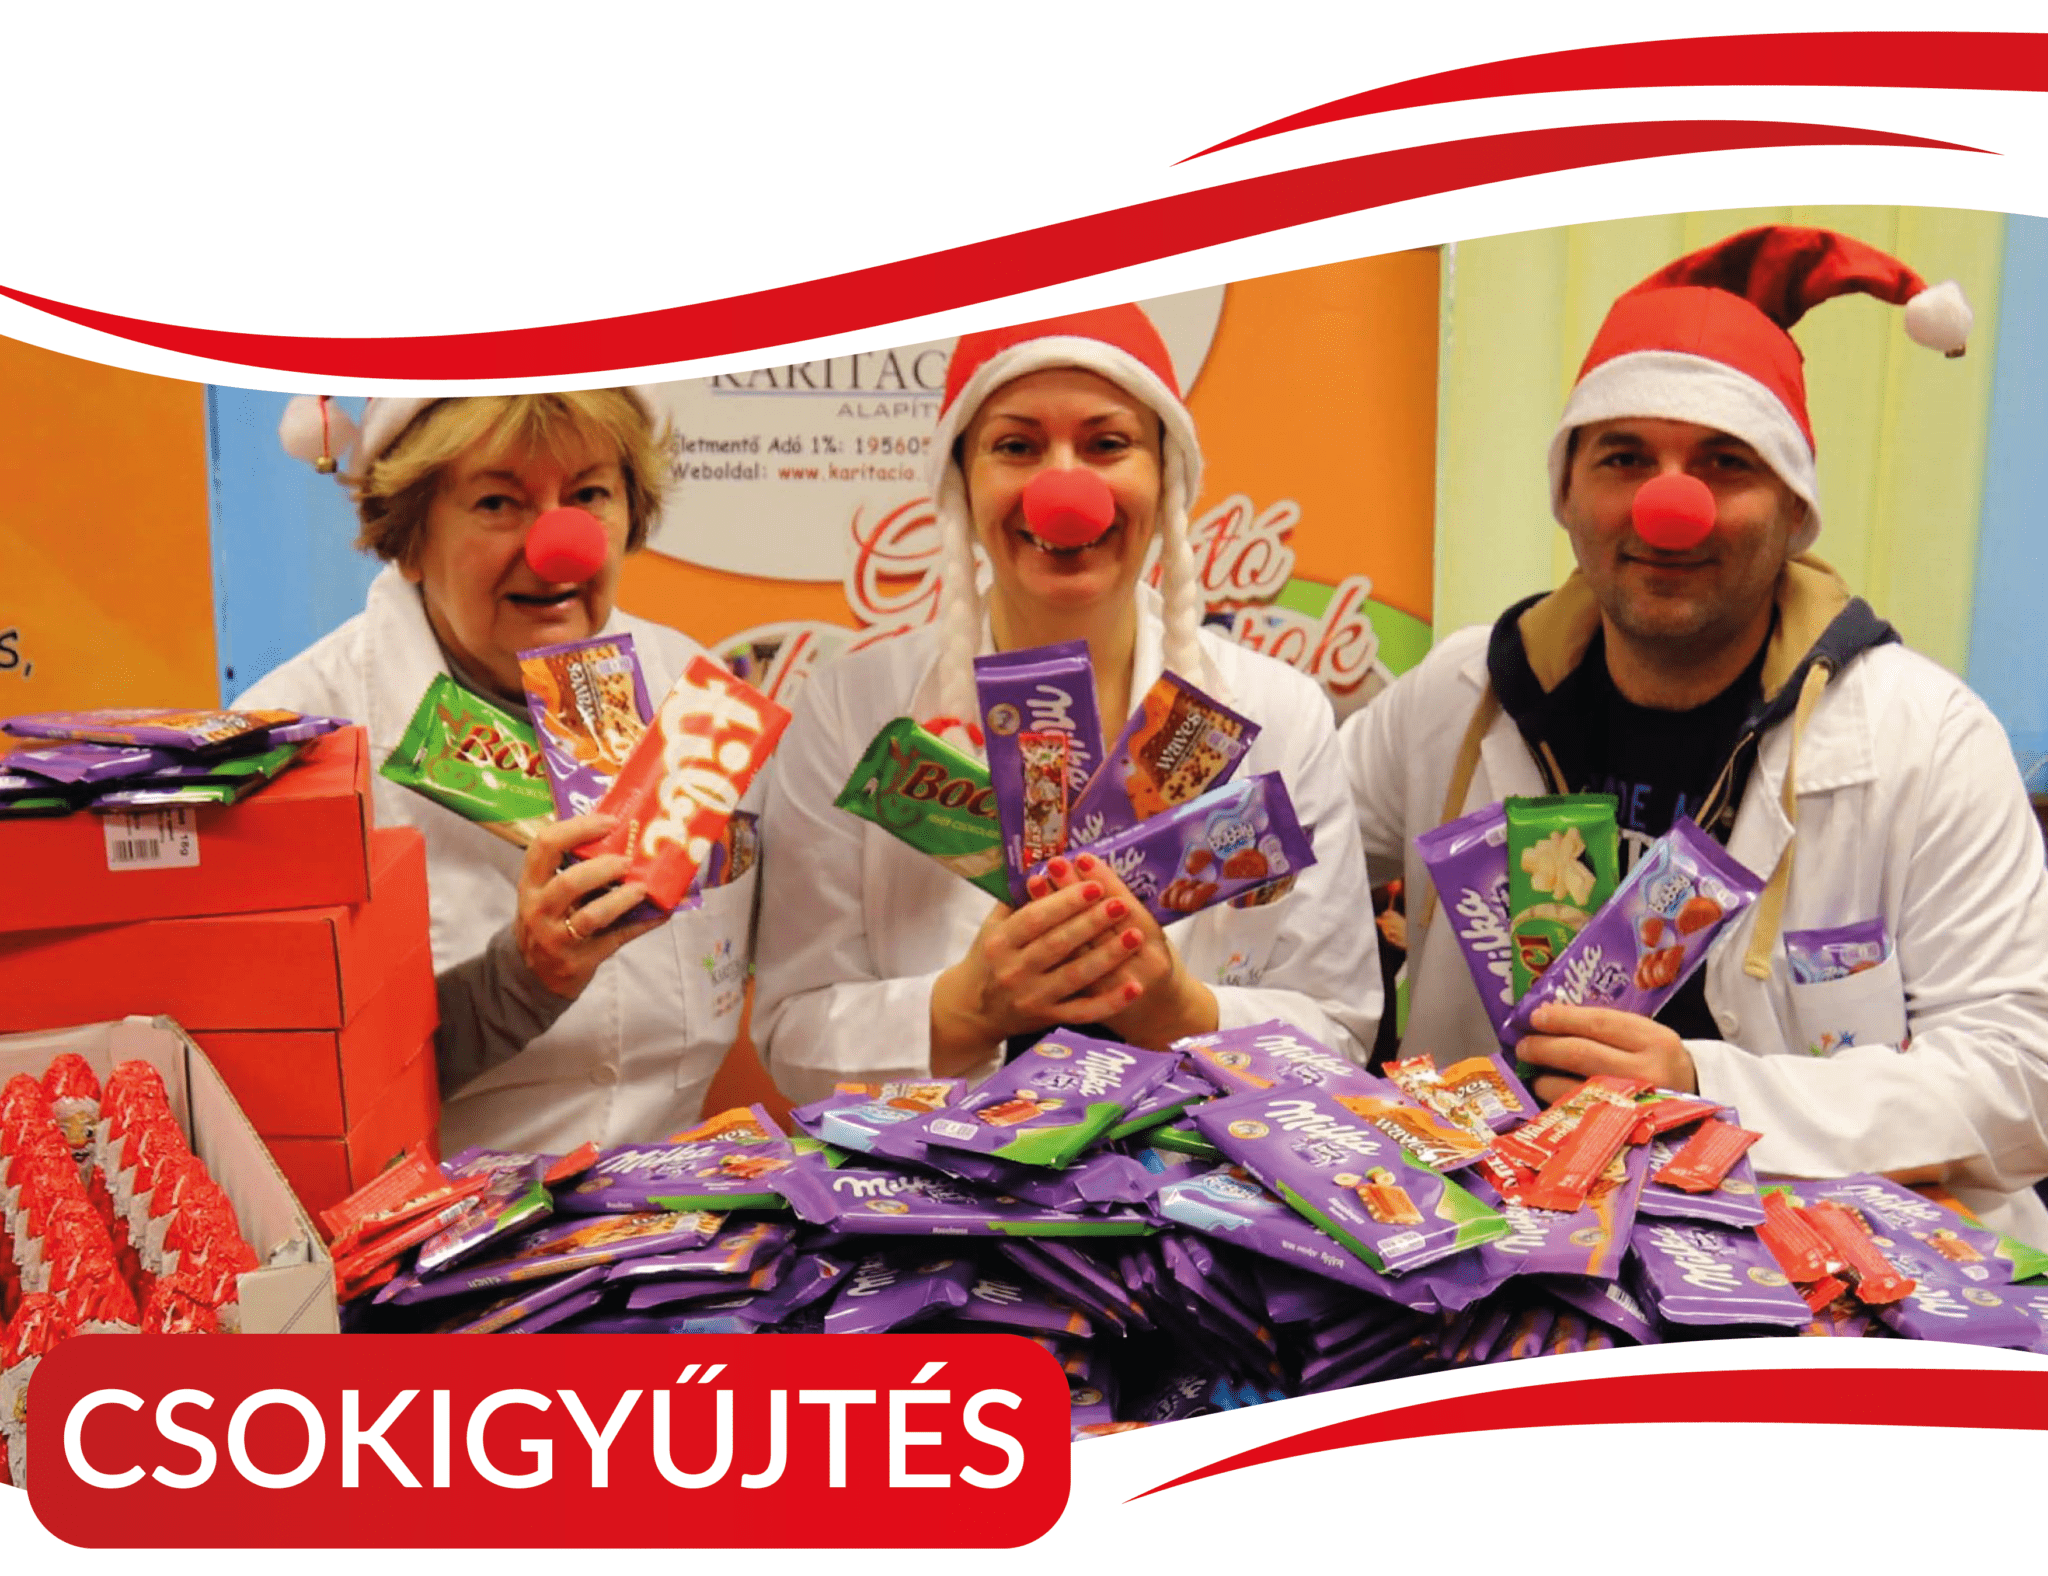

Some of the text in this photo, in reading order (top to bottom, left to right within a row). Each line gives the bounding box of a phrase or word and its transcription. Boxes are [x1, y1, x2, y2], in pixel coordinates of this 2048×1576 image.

[837, 401, 940, 419] ALAPÍT
[767, 434, 801, 454] Adó
[811, 435, 842, 455] 1%:
[670, 460, 921, 482] Weboldal: www.karitacio.
[454, 725, 548, 780] Boc
[1155, 705, 1203, 771] waves
[899, 761, 997, 820] Boc
[1075, 1047, 1137, 1097] Milka
[1253, 1034, 1354, 1077] Milka
[1263, 1099, 1382, 1157] Milka
[595, 1143, 716, 1174] Milka
[1648, 1224, 1743, 1292] Milka
